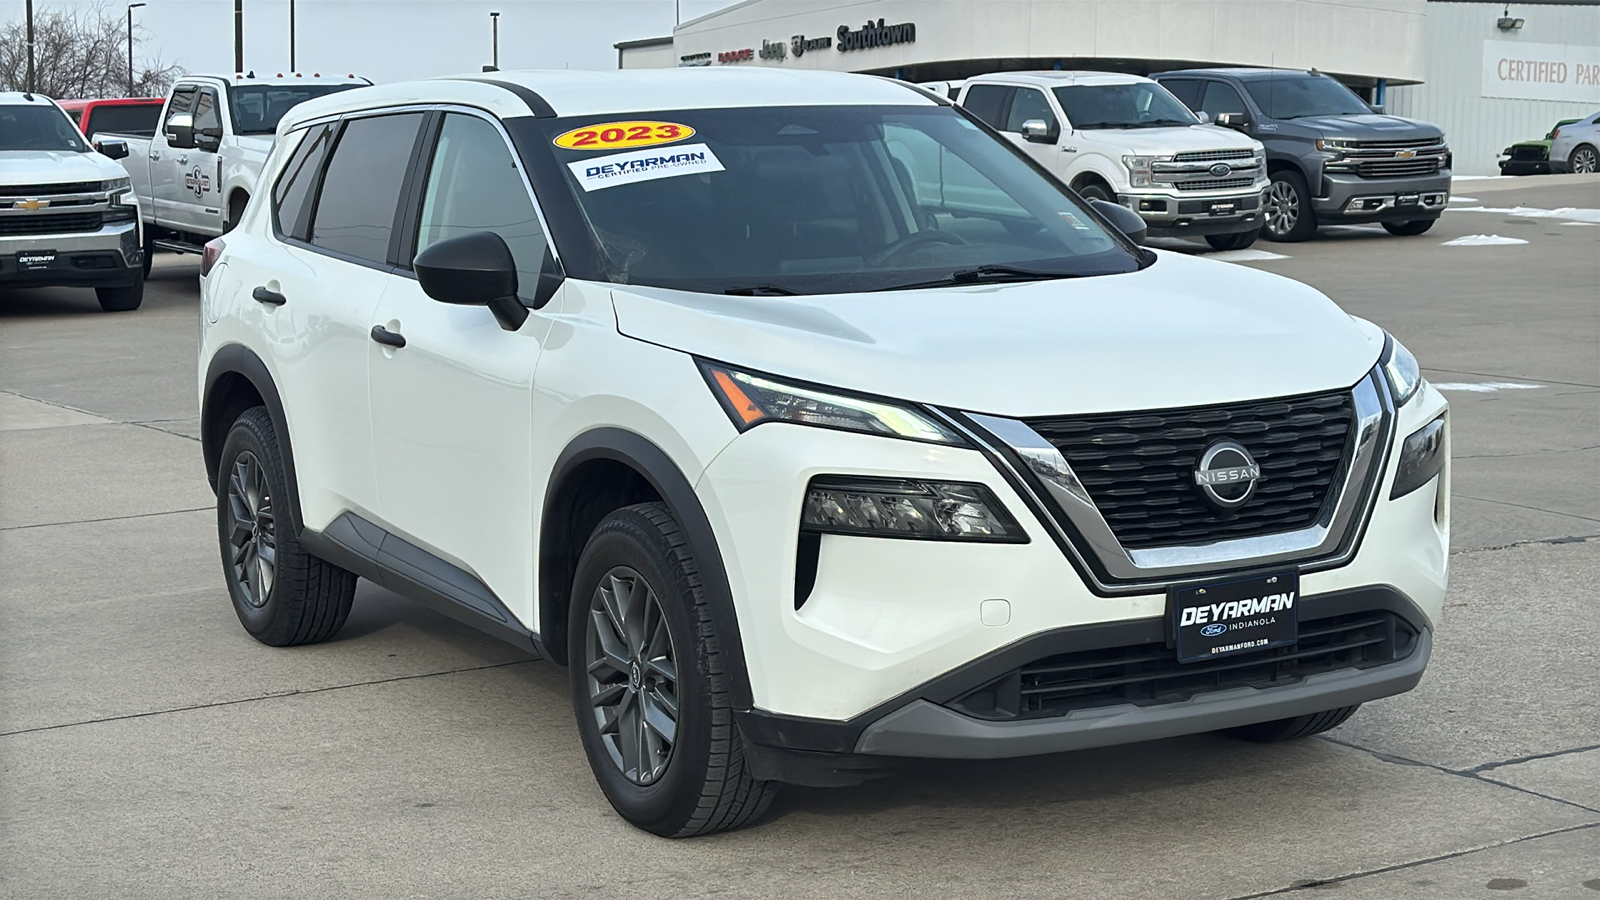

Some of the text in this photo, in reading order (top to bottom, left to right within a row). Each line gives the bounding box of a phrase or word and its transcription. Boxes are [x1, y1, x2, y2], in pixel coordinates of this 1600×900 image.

[802, 37, 832, 51] RAM
[837, 18, 916, 52] Southtown
[759, 38, 787, 61] Jeep
[1497, 58, 1567, 84] CERTIFIED
[572, 125, 682, 147] 2023
[586, 152, 705, 177] DEYARMAN
[597, 159, 707, 180] CERTIFIED PRE-OWNED
[1197, 467, 1259, 483] NISSAN
[1180, 591, 1295, 627] DEYARMAN
[1229, 616, 1276, 631] INDIANOLA
[1211, 638, 1269, 654] DEYARMANFORD.COM
